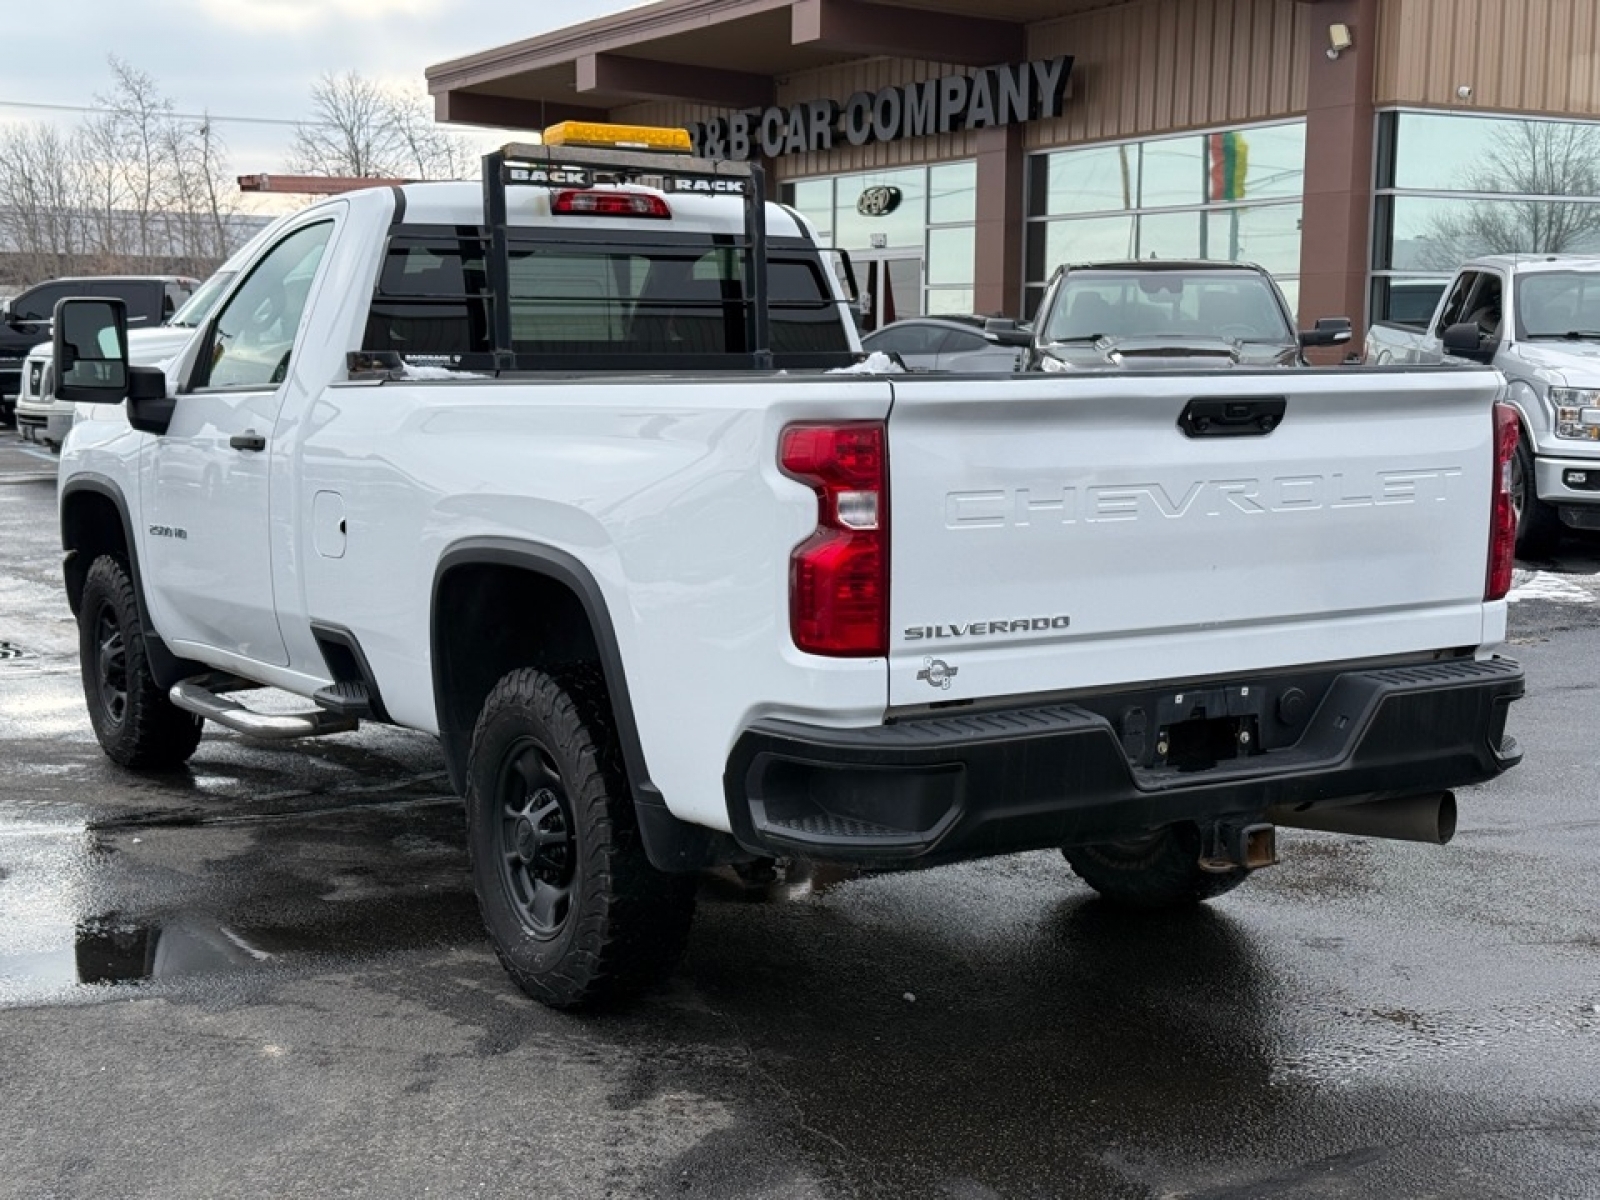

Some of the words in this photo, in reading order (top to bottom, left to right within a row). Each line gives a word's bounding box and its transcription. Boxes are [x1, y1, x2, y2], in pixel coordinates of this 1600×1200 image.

[762, 100, 831, 157] CAR
[847, 55, 1068, 145] COMPANY
[510, 169, 585, 184] BACK
[675, 179, 745, 192] RACK
[859, 190, 890, 213] OPEN
[945, 467, 1462, 530] CHEVROLET
[904, 615, 1071, 641] SILVERADO
